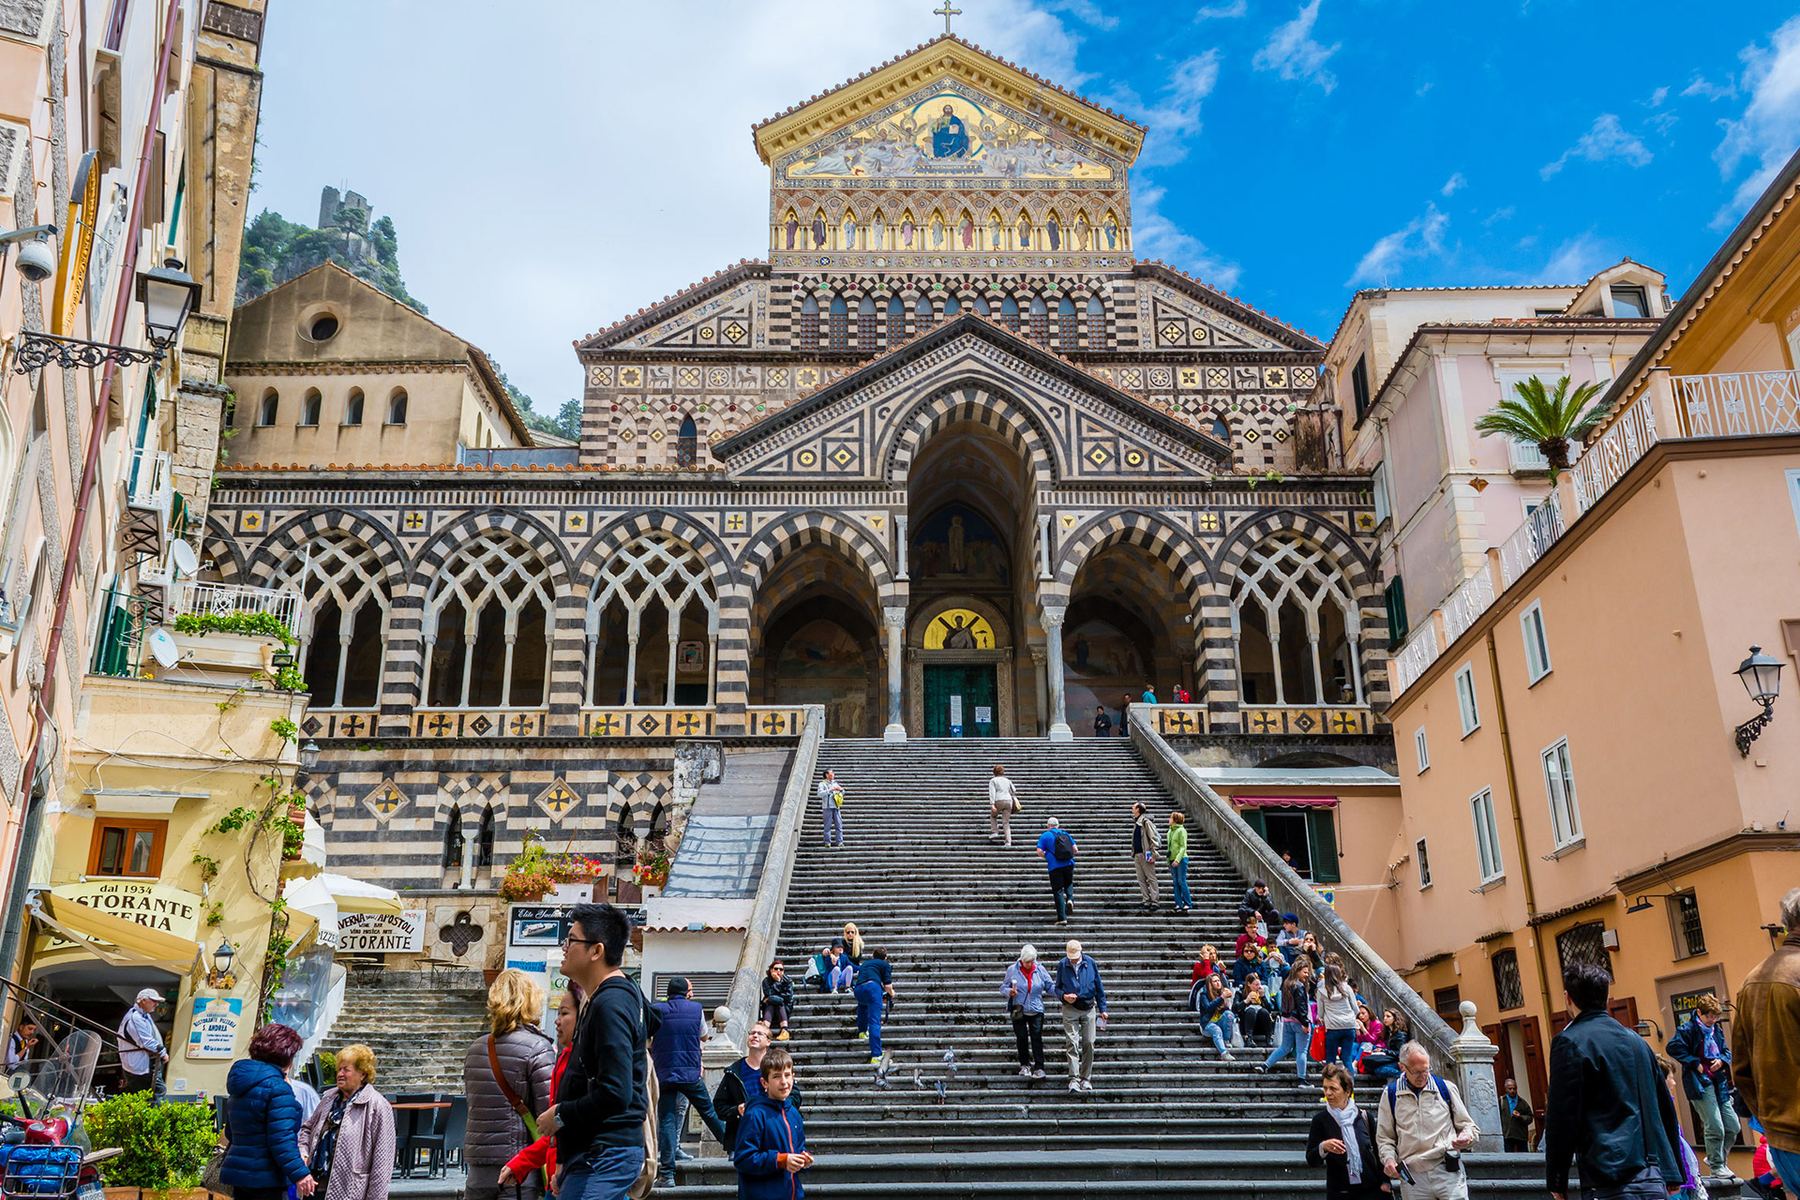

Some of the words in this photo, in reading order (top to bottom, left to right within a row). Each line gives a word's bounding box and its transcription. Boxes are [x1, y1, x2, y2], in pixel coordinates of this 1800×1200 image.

[99, 884, 118, 893] dal
[124, 885, 153, 895] 1934
[69, 894, 193, 920] STORANTE
[377, 913, 415, 935] APOSTOLI
[340, 936, 412, 950] STORANTE
